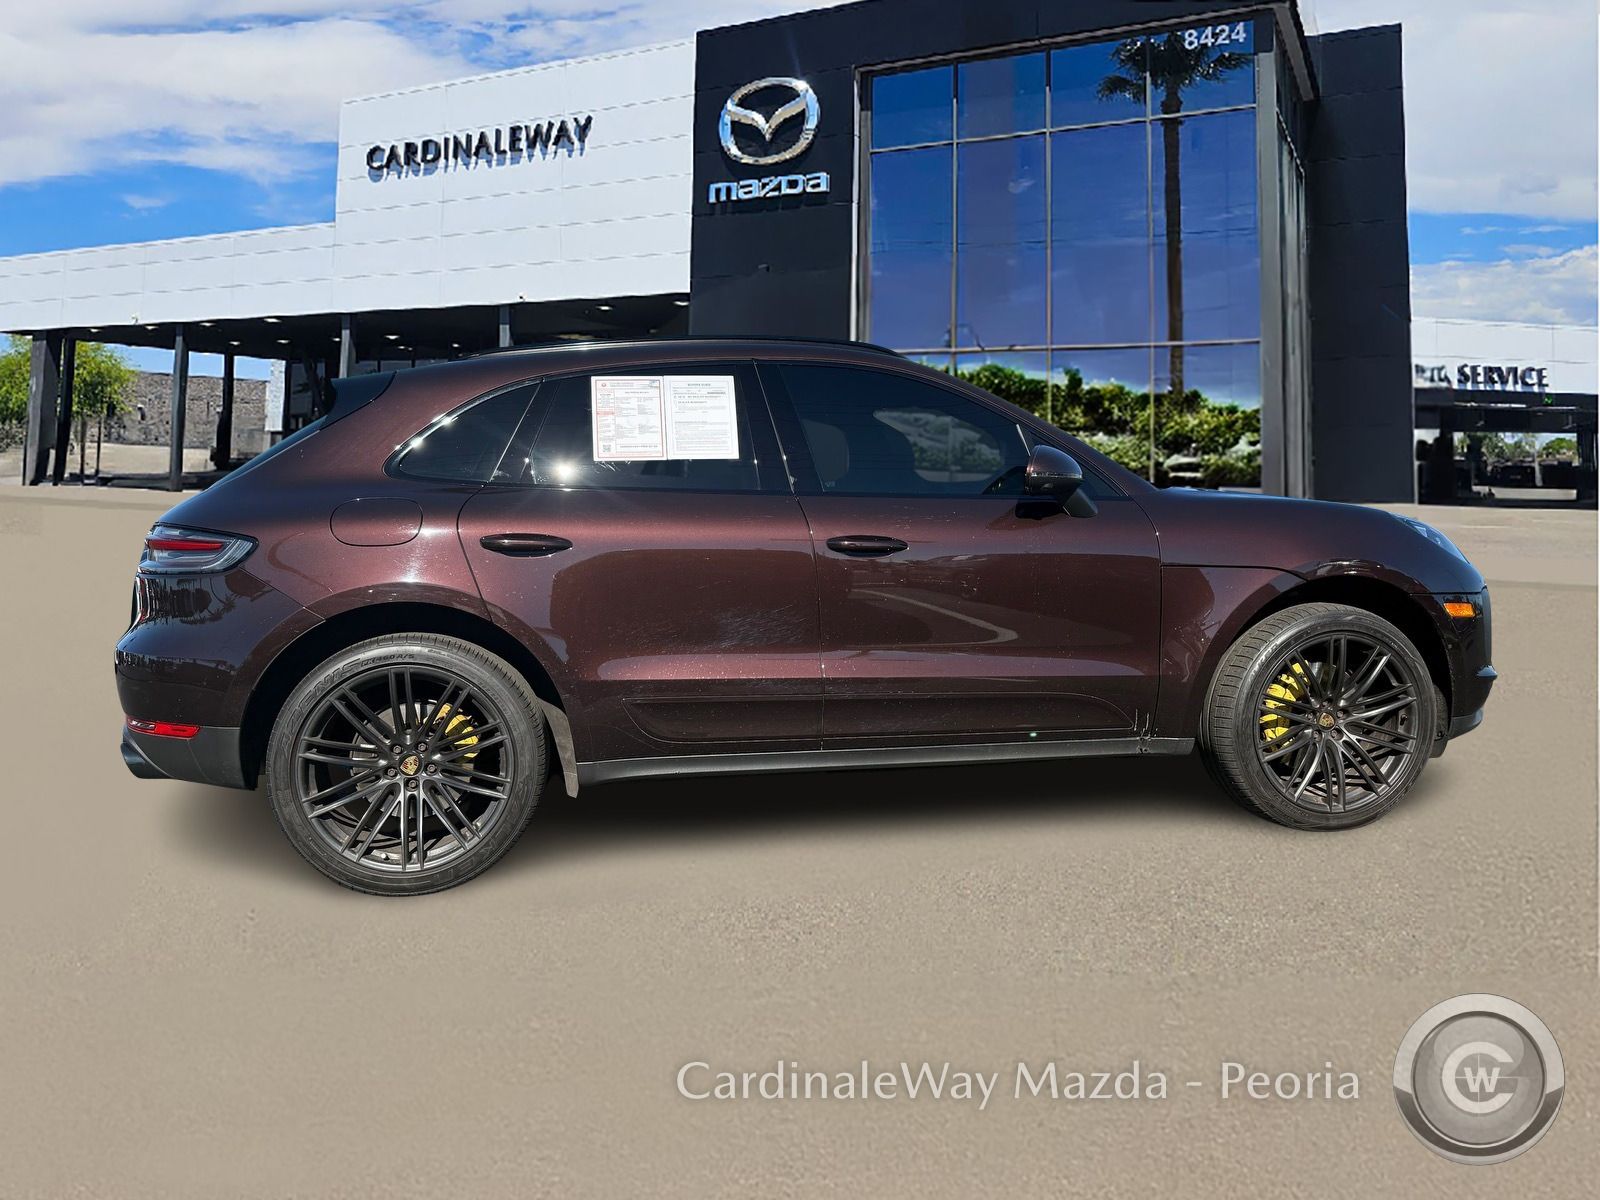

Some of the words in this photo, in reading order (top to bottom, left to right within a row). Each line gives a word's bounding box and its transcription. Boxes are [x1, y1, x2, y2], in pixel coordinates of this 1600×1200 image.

[1184, 22, 1246, 50] 8424
[366, 115, 593, 171] CARDINALEWAY
[1457, 363, 1549, 388] SERVICE
